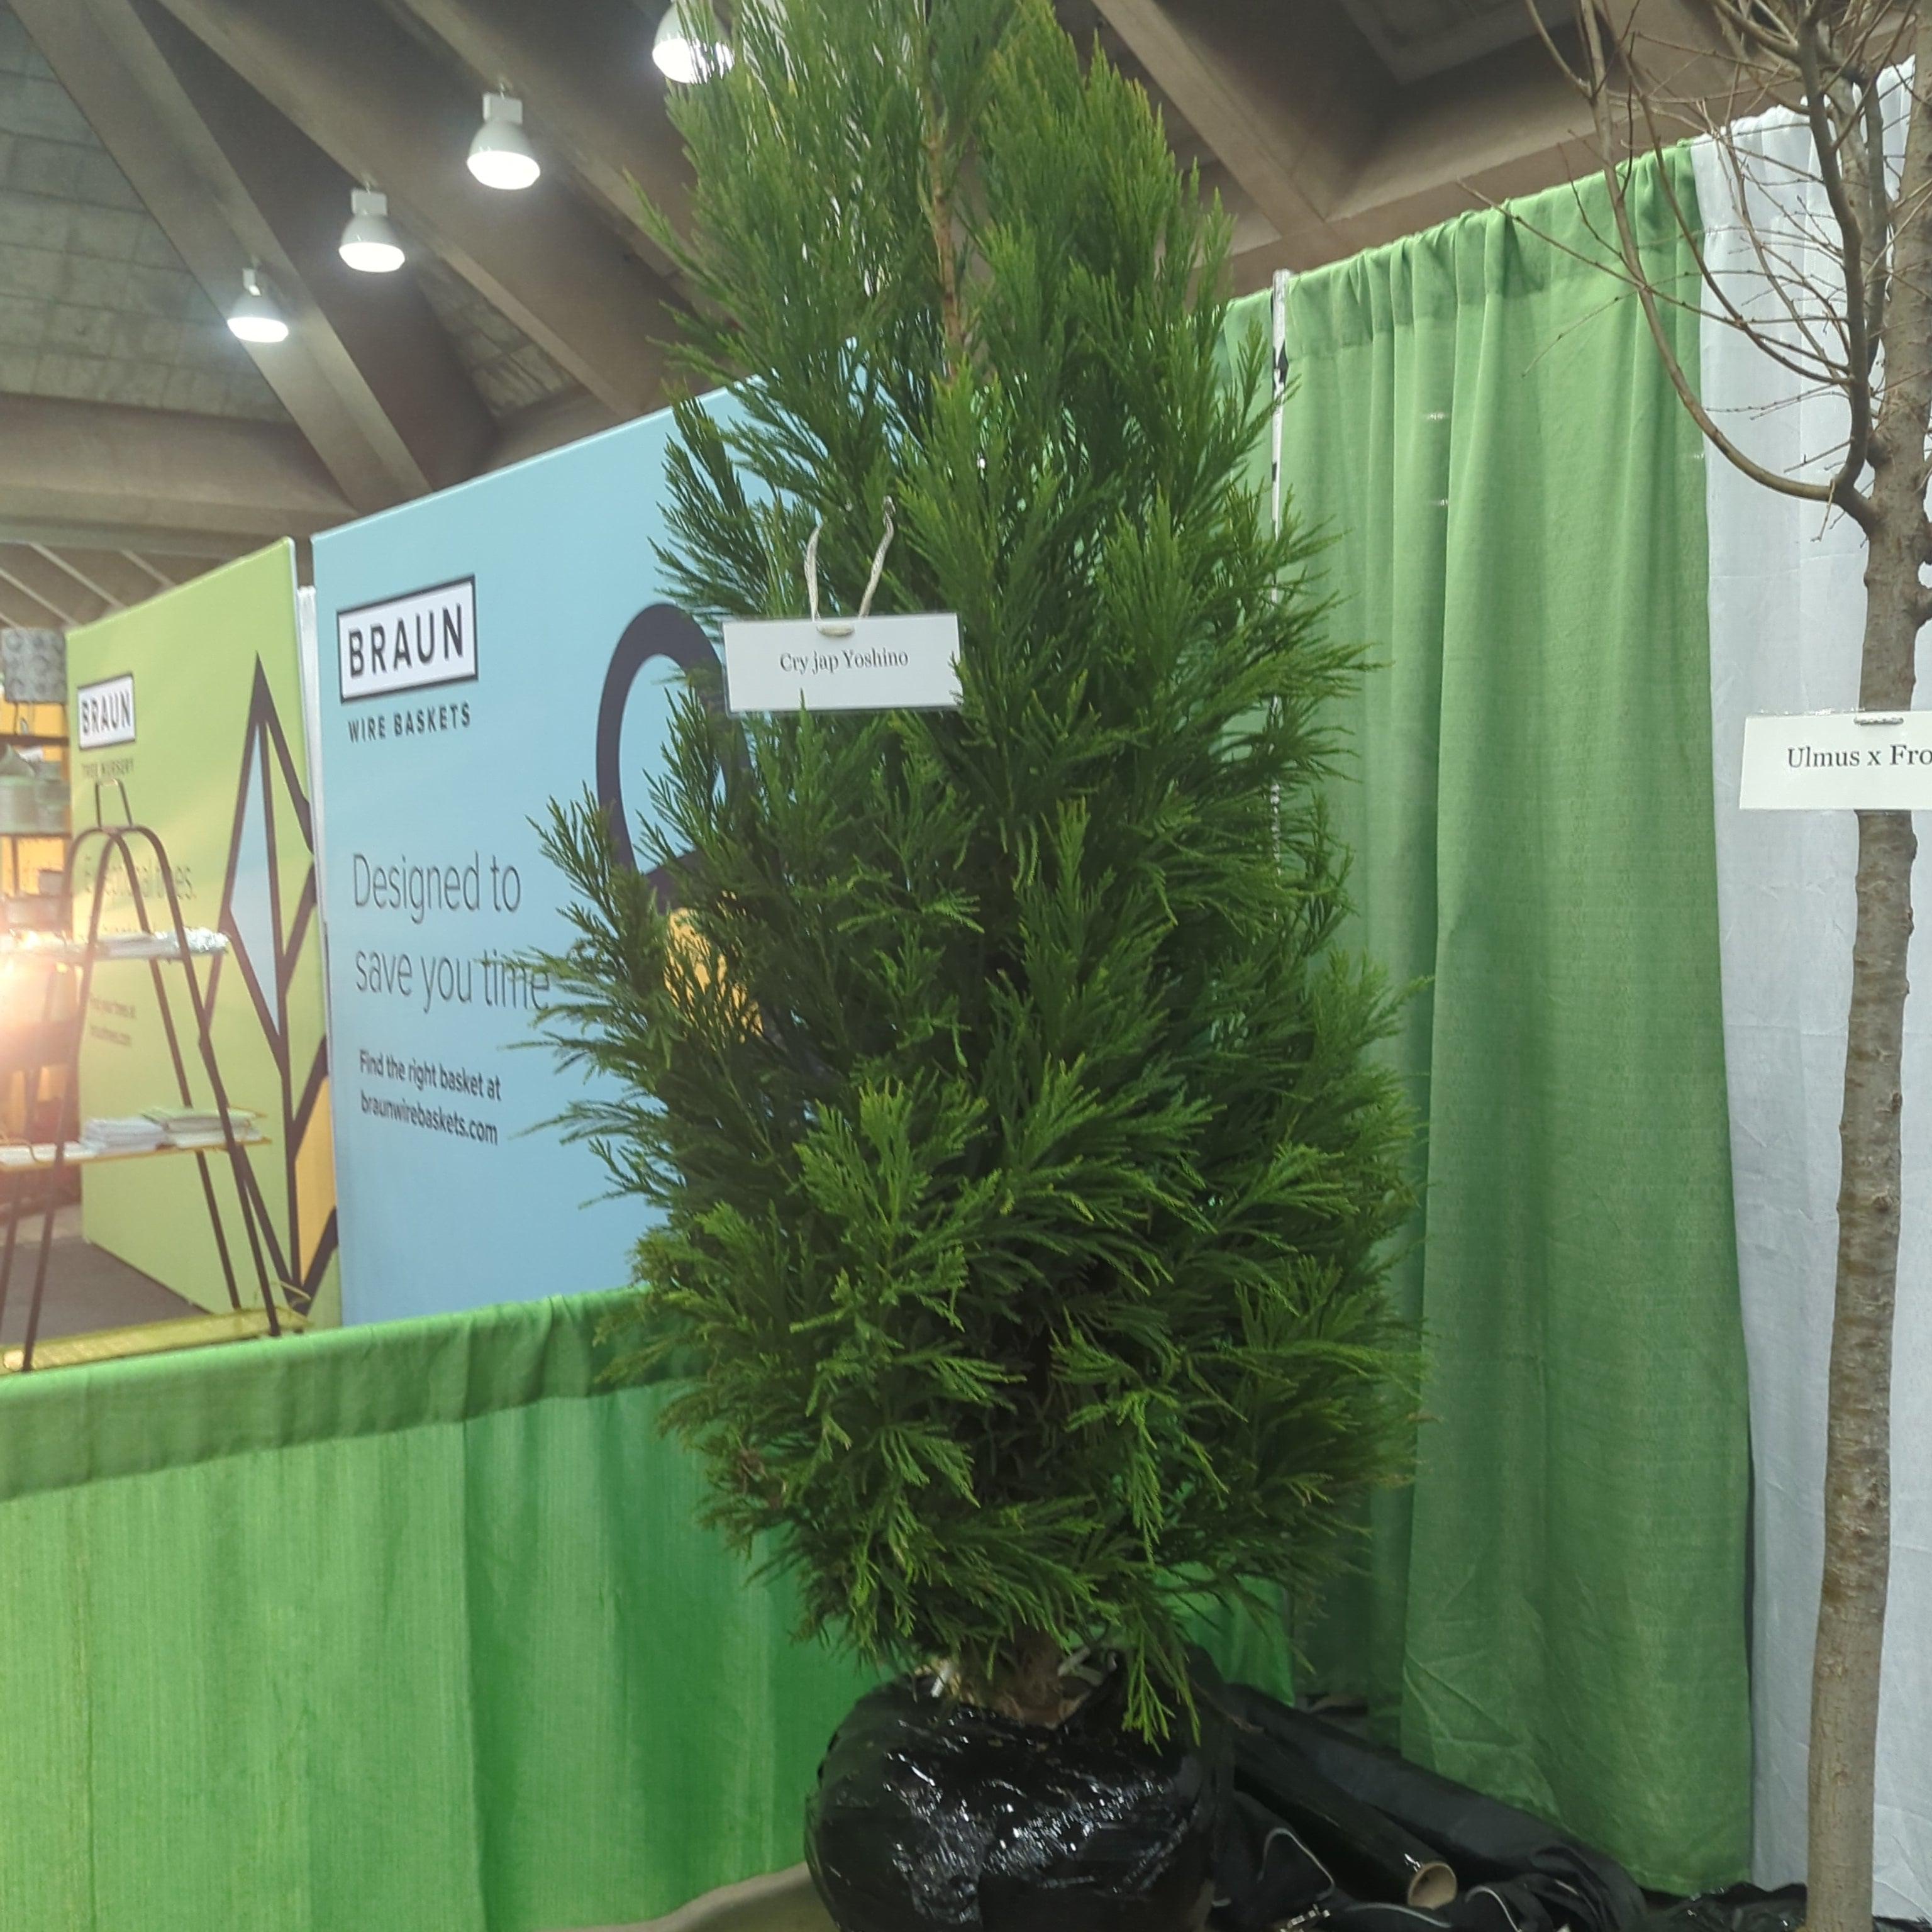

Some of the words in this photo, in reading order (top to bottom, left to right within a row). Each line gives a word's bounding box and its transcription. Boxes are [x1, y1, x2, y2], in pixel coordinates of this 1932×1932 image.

[348, 603, 464, 678] BRAUN
[780, 652, 809, 675] Cry
[811, 650, 839, 674] jap
[841, 647, 909, 669] Yoshino
[82, 690, 131, 735] BRAUN
[348, 715, 386, 743] WIRE
[394, 701, 470, 736] BASKETS
[1788, 745, 1860, 768] Ulmus
[1867, 750, 1882, 765] x
[1889, 745, 1932, 765] Fro
[353, 851, 480, 924] Designed
[491, 855, 521, 912] to
[356, 950, 413, 996] save
[421, 956, 471, 1013] you
[482, 948, 549, 1011] time
[360, 1049, 384, 1077] Find
[386, 1053, 406, 1082] the
[409, 1057, 437, 1091] right
[440, 1063, 484, 1098] basket
[487, 1075, 502, 1101] at
[361, 1089, 498, 1145] braunwirebaskets.com
